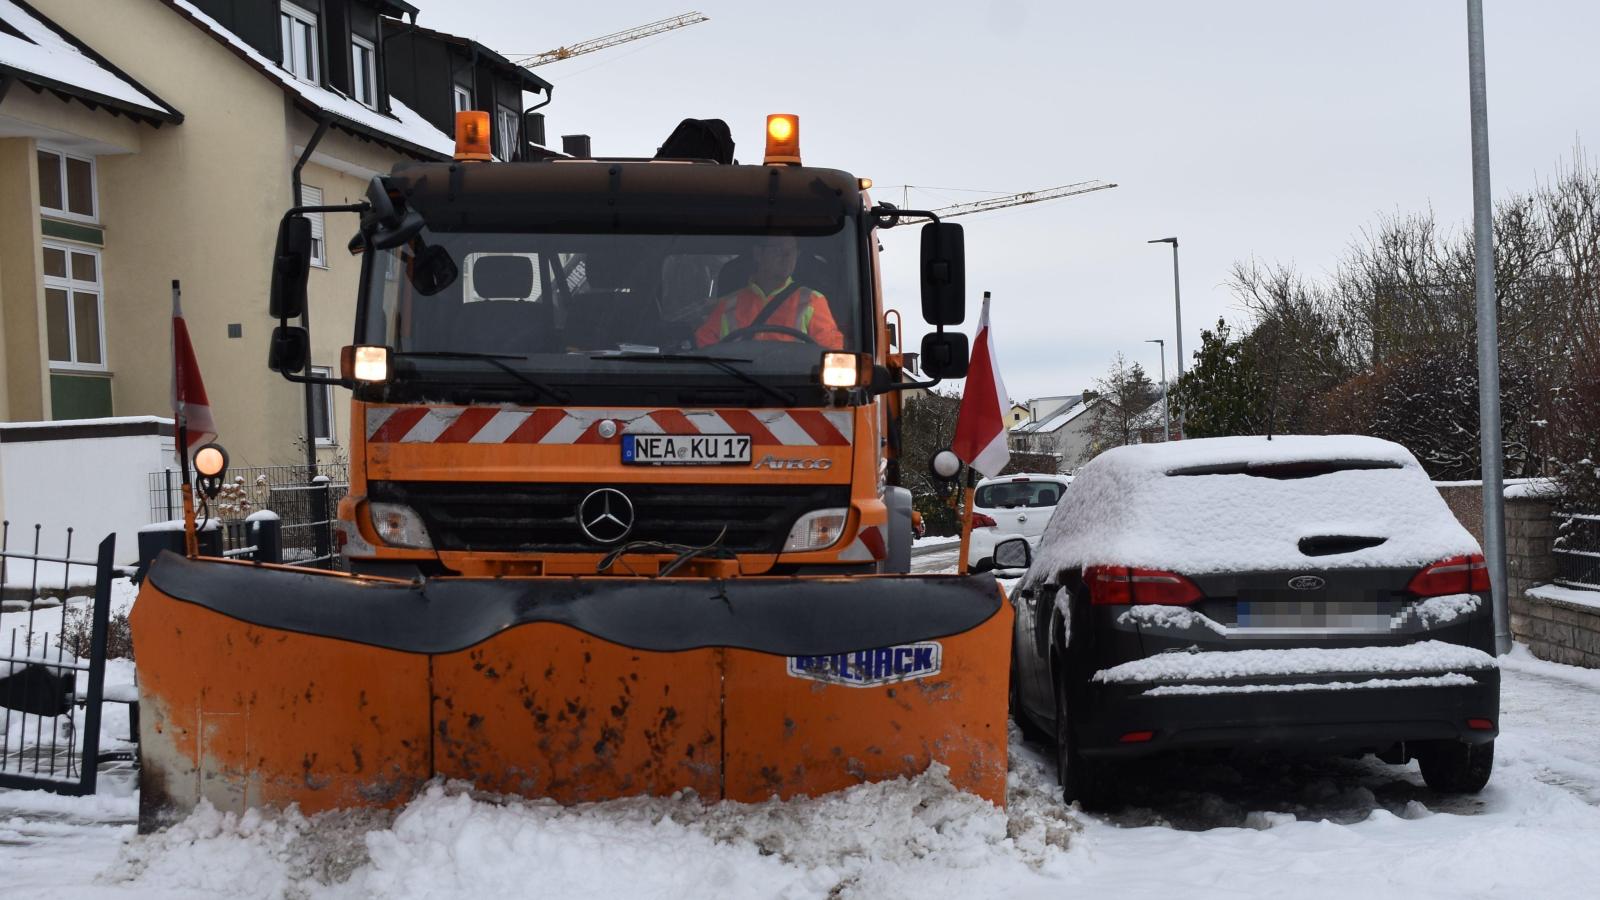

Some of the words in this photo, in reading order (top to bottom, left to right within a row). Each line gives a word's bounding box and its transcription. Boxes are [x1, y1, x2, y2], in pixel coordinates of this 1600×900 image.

[635, 438, 677, 459] NEA
[691, 438, 719, 459] KU
[723, 438, 750, 459] 17
